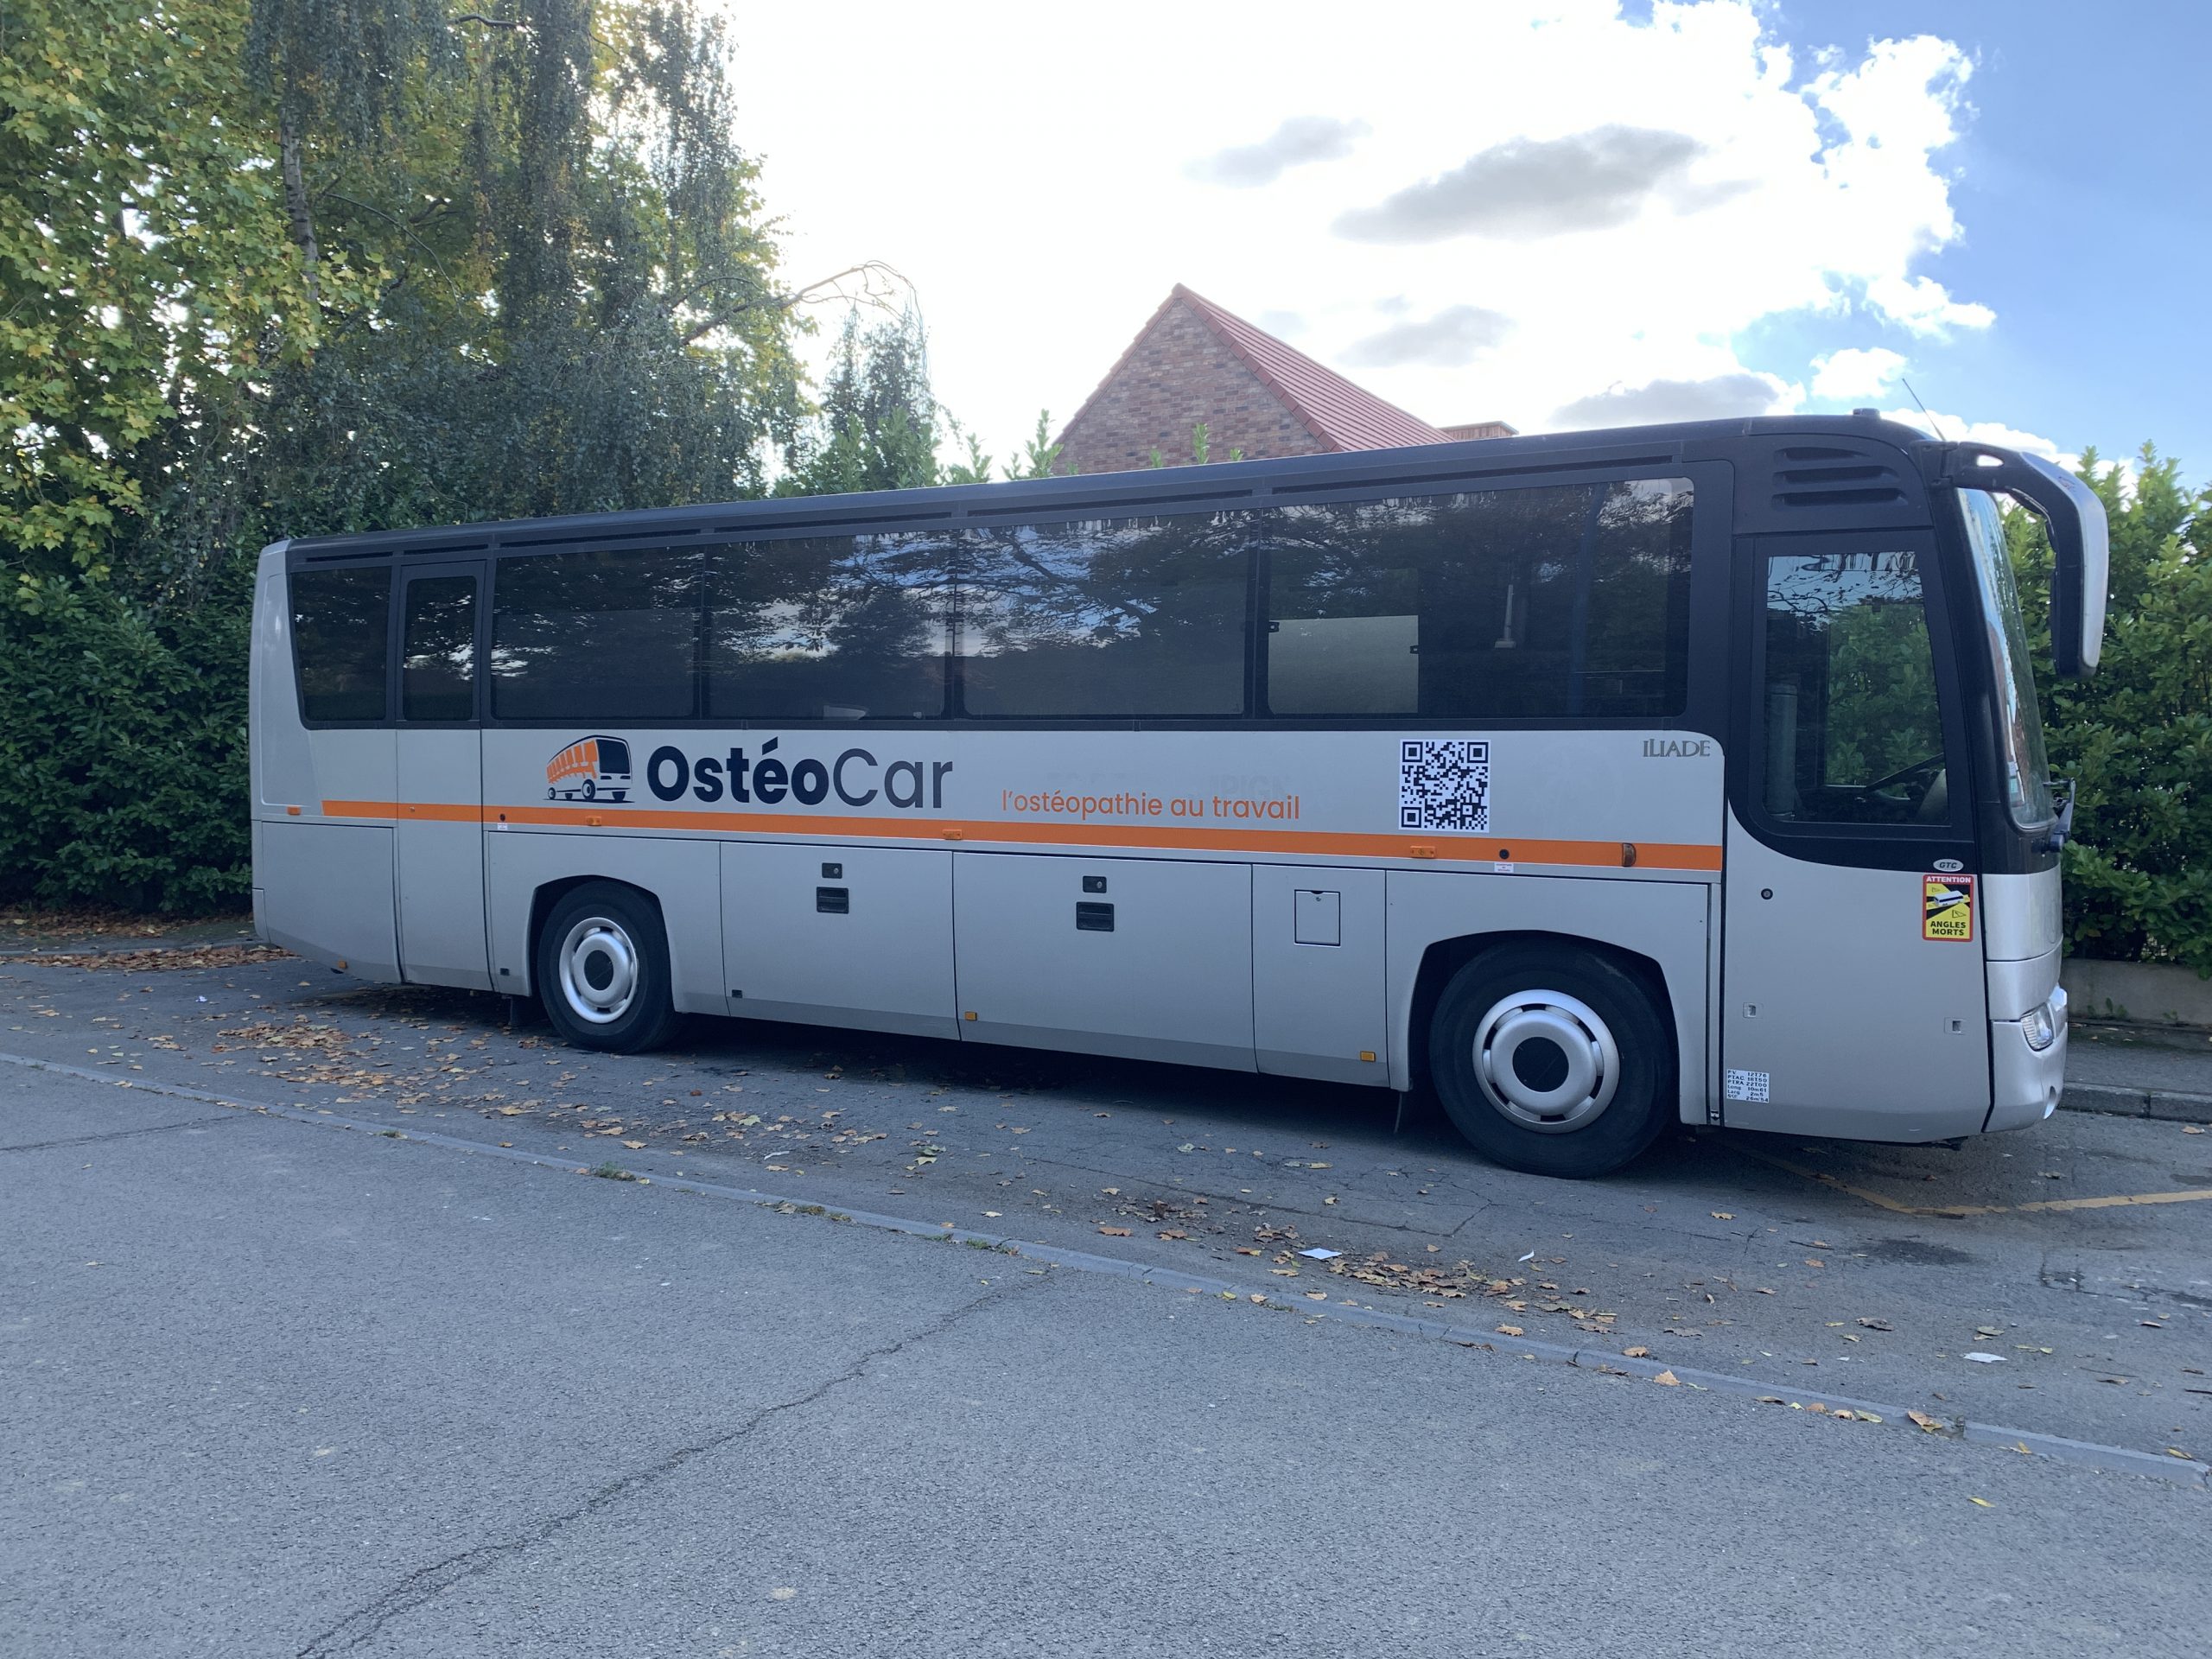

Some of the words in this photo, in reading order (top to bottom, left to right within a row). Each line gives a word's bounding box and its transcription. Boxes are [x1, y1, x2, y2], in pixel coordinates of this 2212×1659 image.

[1643, 738, 1711, 757] ILIADE
[646, 736, 954, 809] OstéoCar
[1002, 790, 1162, 820] l'ostéopathie
[1170, 799, 1204, 817] au
[1212, 795, 1300, 820] travail
